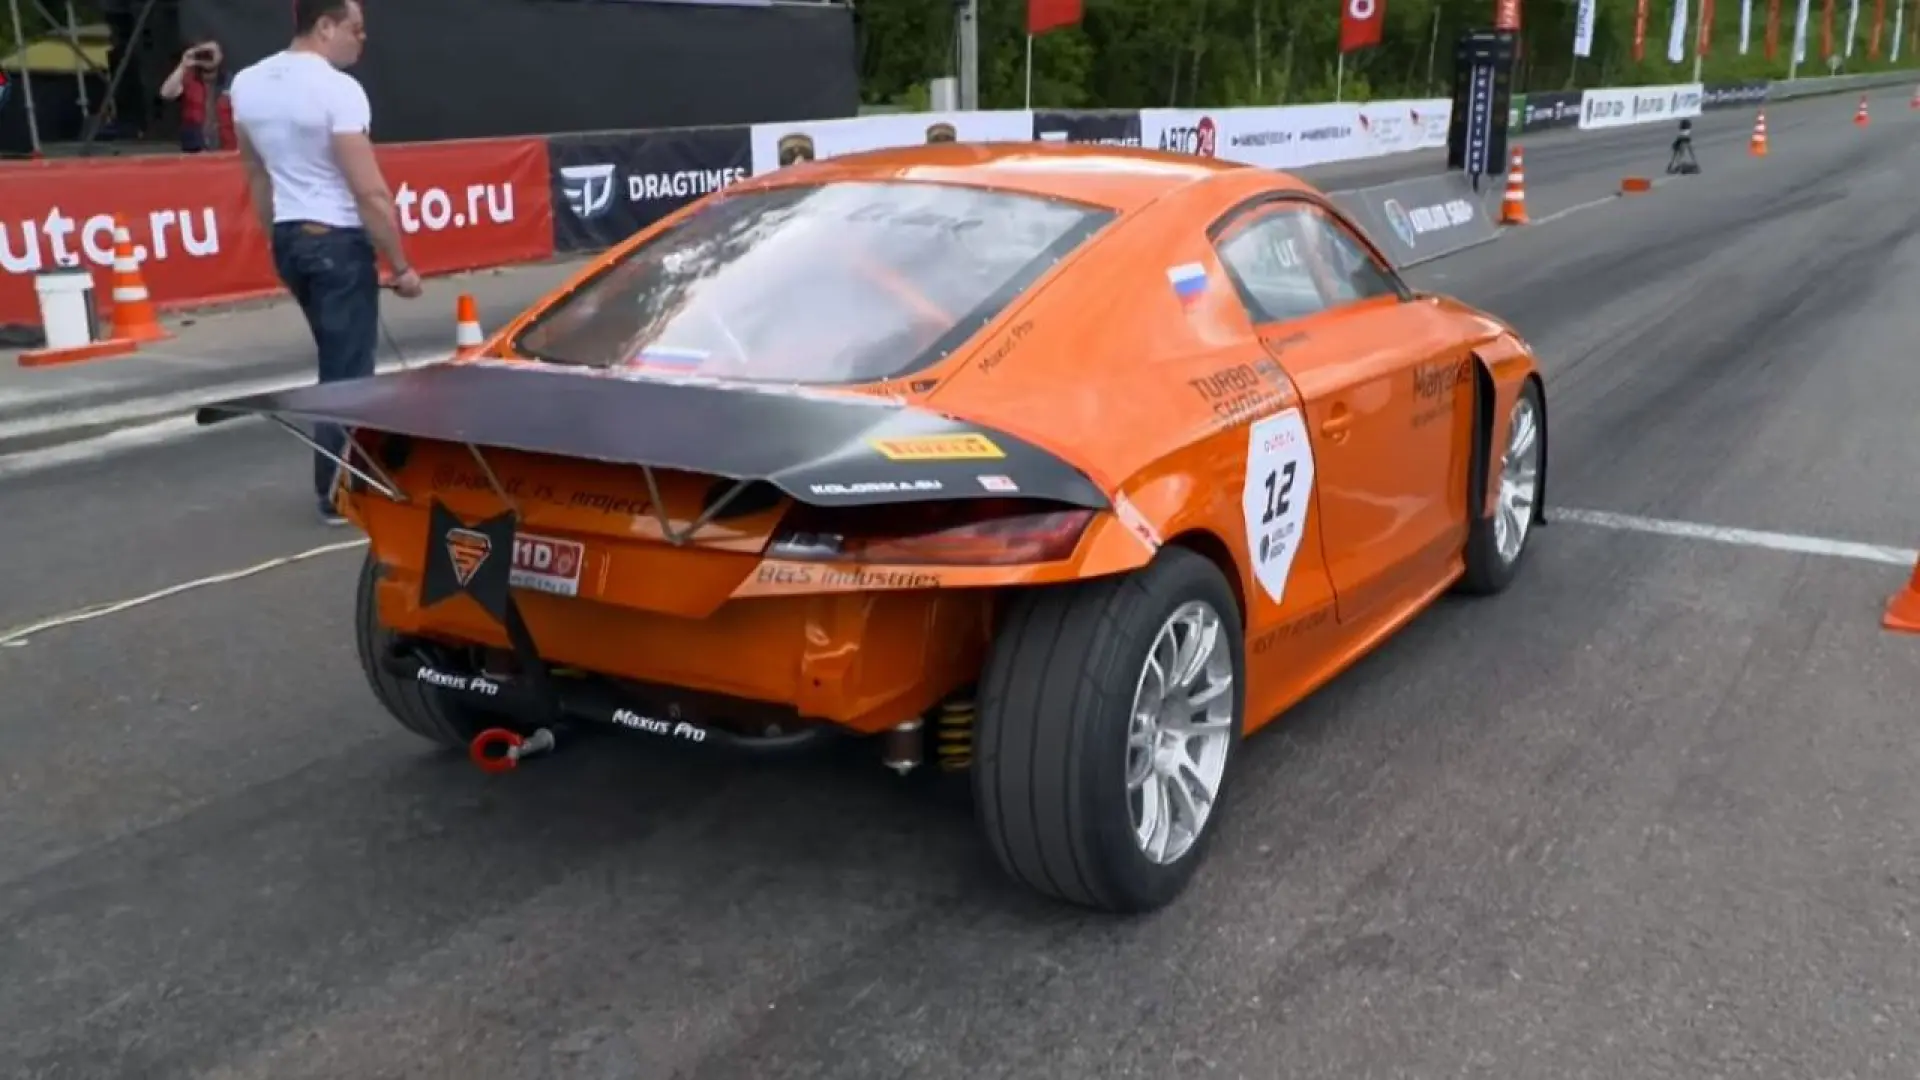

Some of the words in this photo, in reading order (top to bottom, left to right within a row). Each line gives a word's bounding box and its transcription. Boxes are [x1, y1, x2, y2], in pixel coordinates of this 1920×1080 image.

[1188, 363, 1259, 402] TURBO
[1262, 460, 1297, 525] 12
[417, 666, 467, 691] Maxus
[470, 679, 499, 696] Pro
[611, 707, 671, 734] Maxus
[675, 721, 707, 743] Pro
